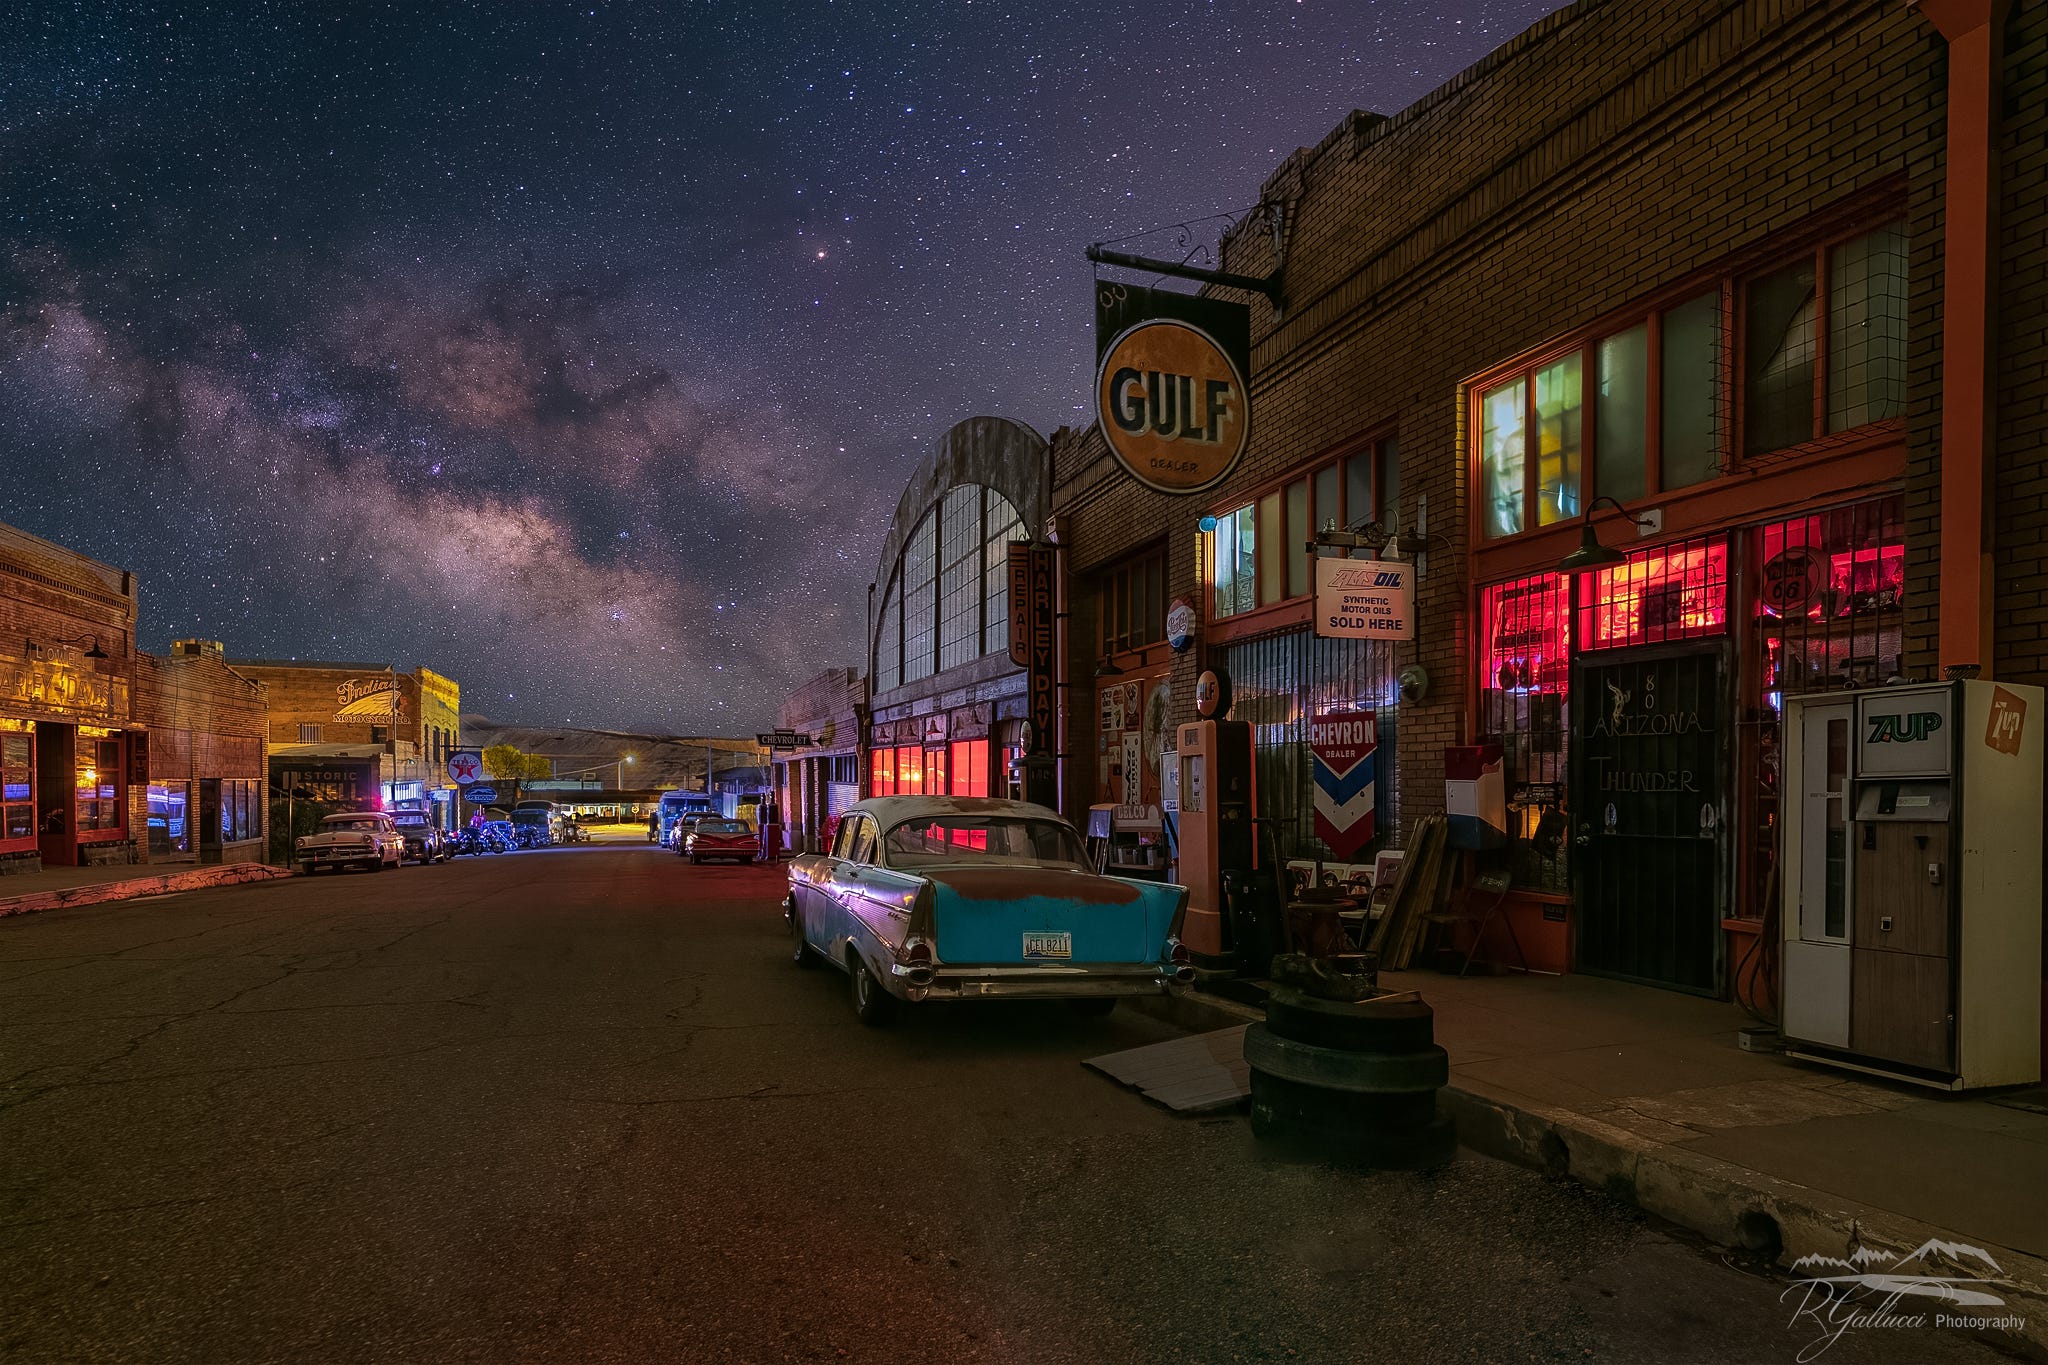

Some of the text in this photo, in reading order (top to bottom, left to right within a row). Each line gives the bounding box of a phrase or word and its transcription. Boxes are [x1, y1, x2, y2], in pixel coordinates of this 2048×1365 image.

[1110, 367, 1235, 444] GULF
[1151, 458, 1199, 473] DEALER
[1328, 568, 1404, 589] AMSOIL
[1773, 581, 1800, 599] 66
[1034, 552, 1050, 667] HARLEY
[1341, 605, 1391, 615] MOTOR OILS
[1343, 596, 1389, 606] SYNTHETIC
[1015, 569, 1027, 655] REPAIR
[1329, 616, 1403, 630] SOLD HERE
[0, 667, 126, 711] ARLEY-DAVIDSON
[1311, 719, 1375, 747] CHEVRON
[1587, 712, 1708, 738] ARIZONA
[761, 736, 808, 745] CHEVROLET
[1326, 750, 1356, 758] DEALER
[297, 771, 357, 780] ISTORIC
[1588, 756, 1701, 793] THUNDER
